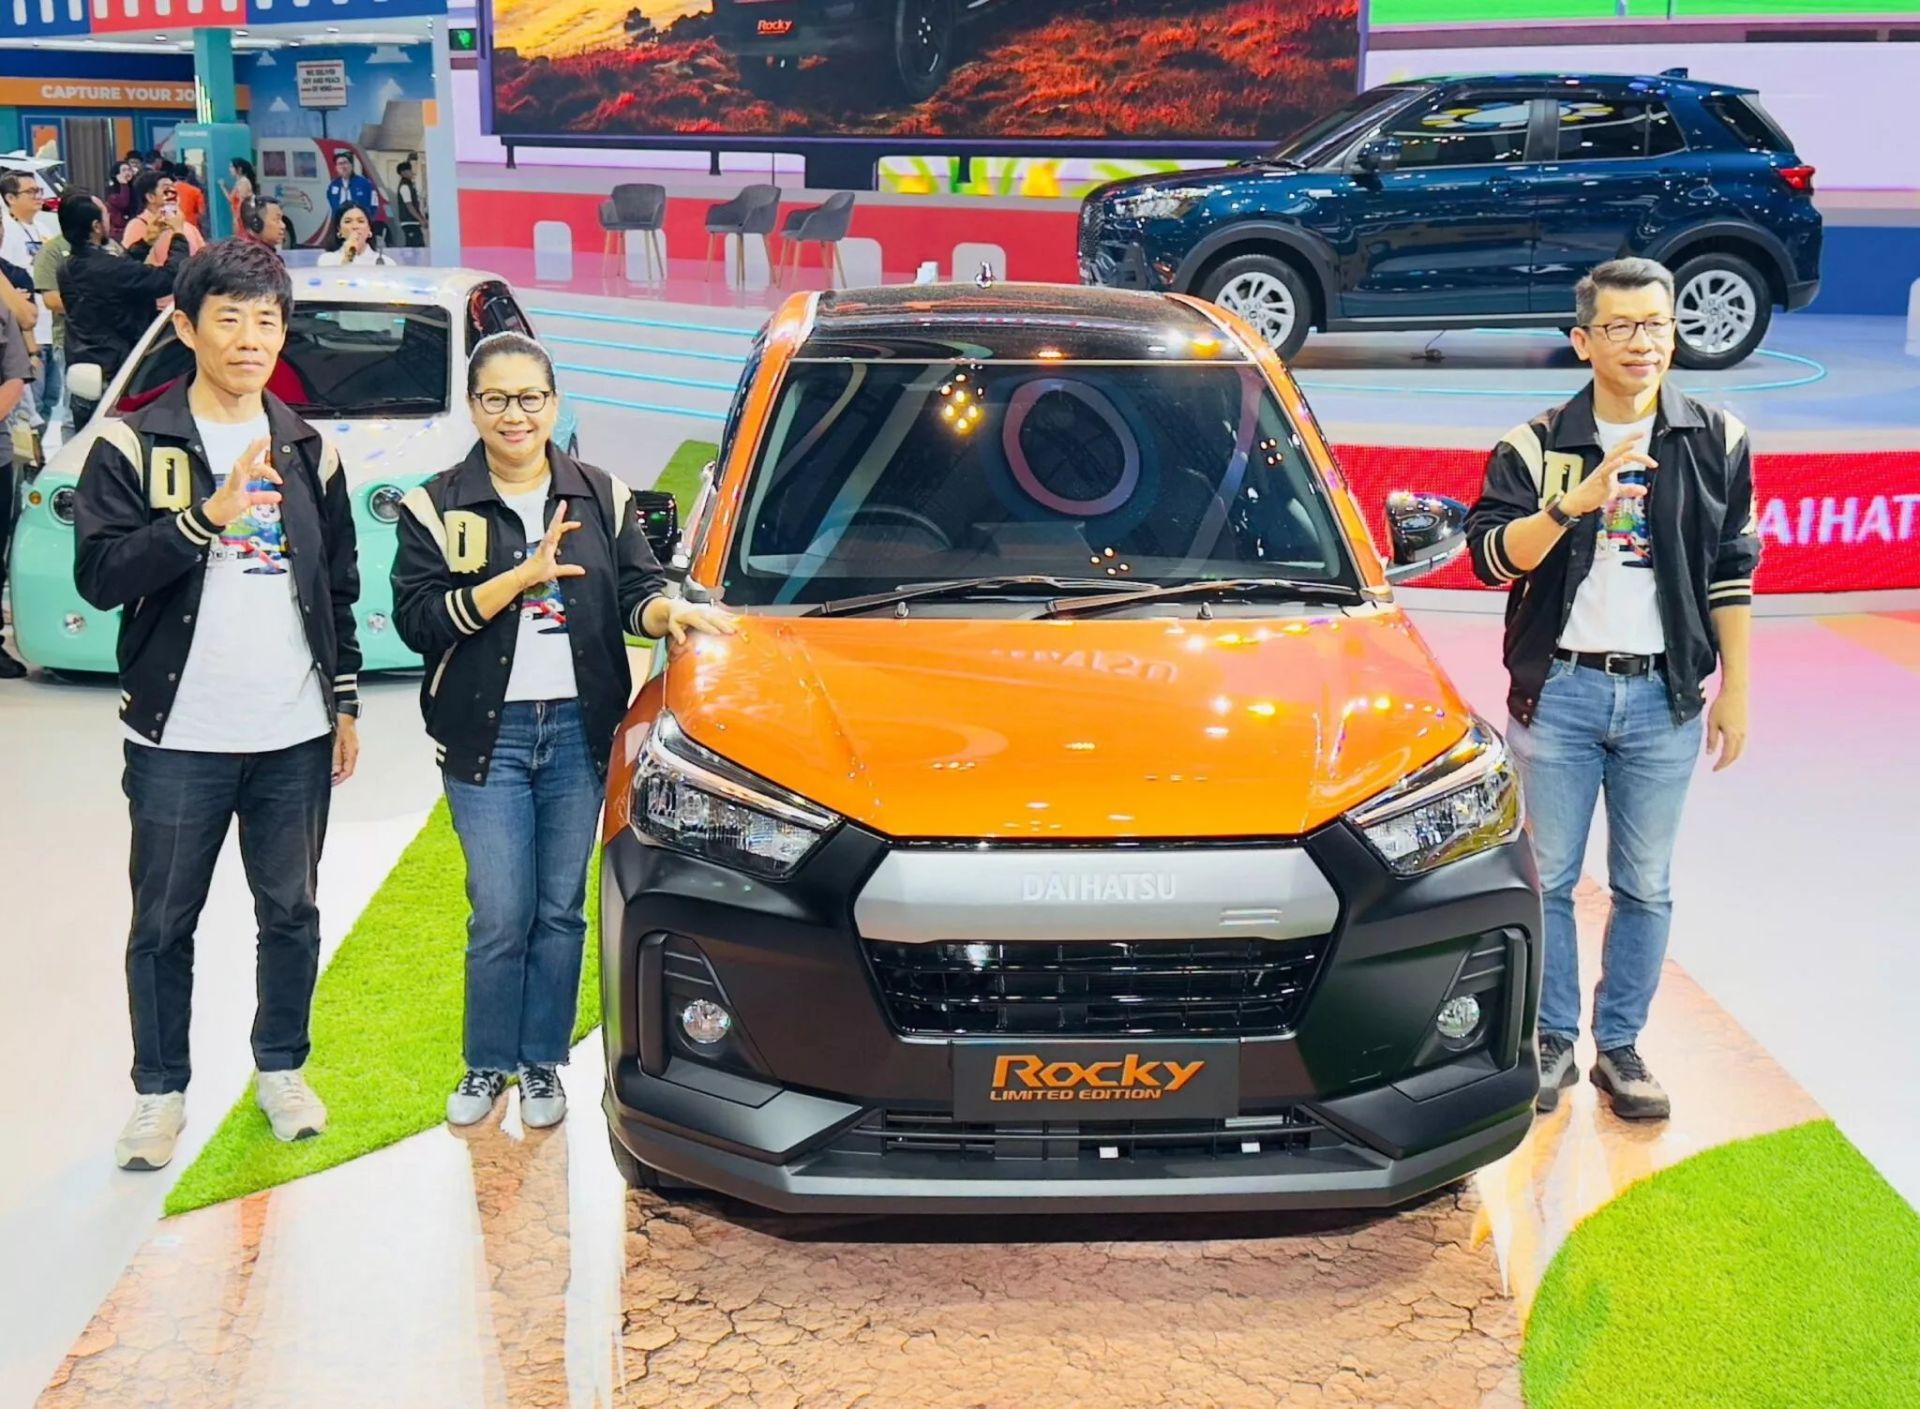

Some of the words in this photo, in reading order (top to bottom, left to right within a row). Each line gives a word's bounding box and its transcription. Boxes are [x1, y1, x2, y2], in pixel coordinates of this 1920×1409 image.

[757, 19, 793, 31] Rocky
[41, 85, 121, 100] CAPTURE
[124, 87, 171, 101] YOUR
[175, 88, 197, 101] JO
[1741, 493, 1920, 545] AIHAT
[1022, 873, 1177, 901] DAIHATSU
[992, 1053, 1206, 1091] Rocky
[990, 1089, 1074, 1101] LIMITED
[1078, 1088, 1163, 1101] EDITION
